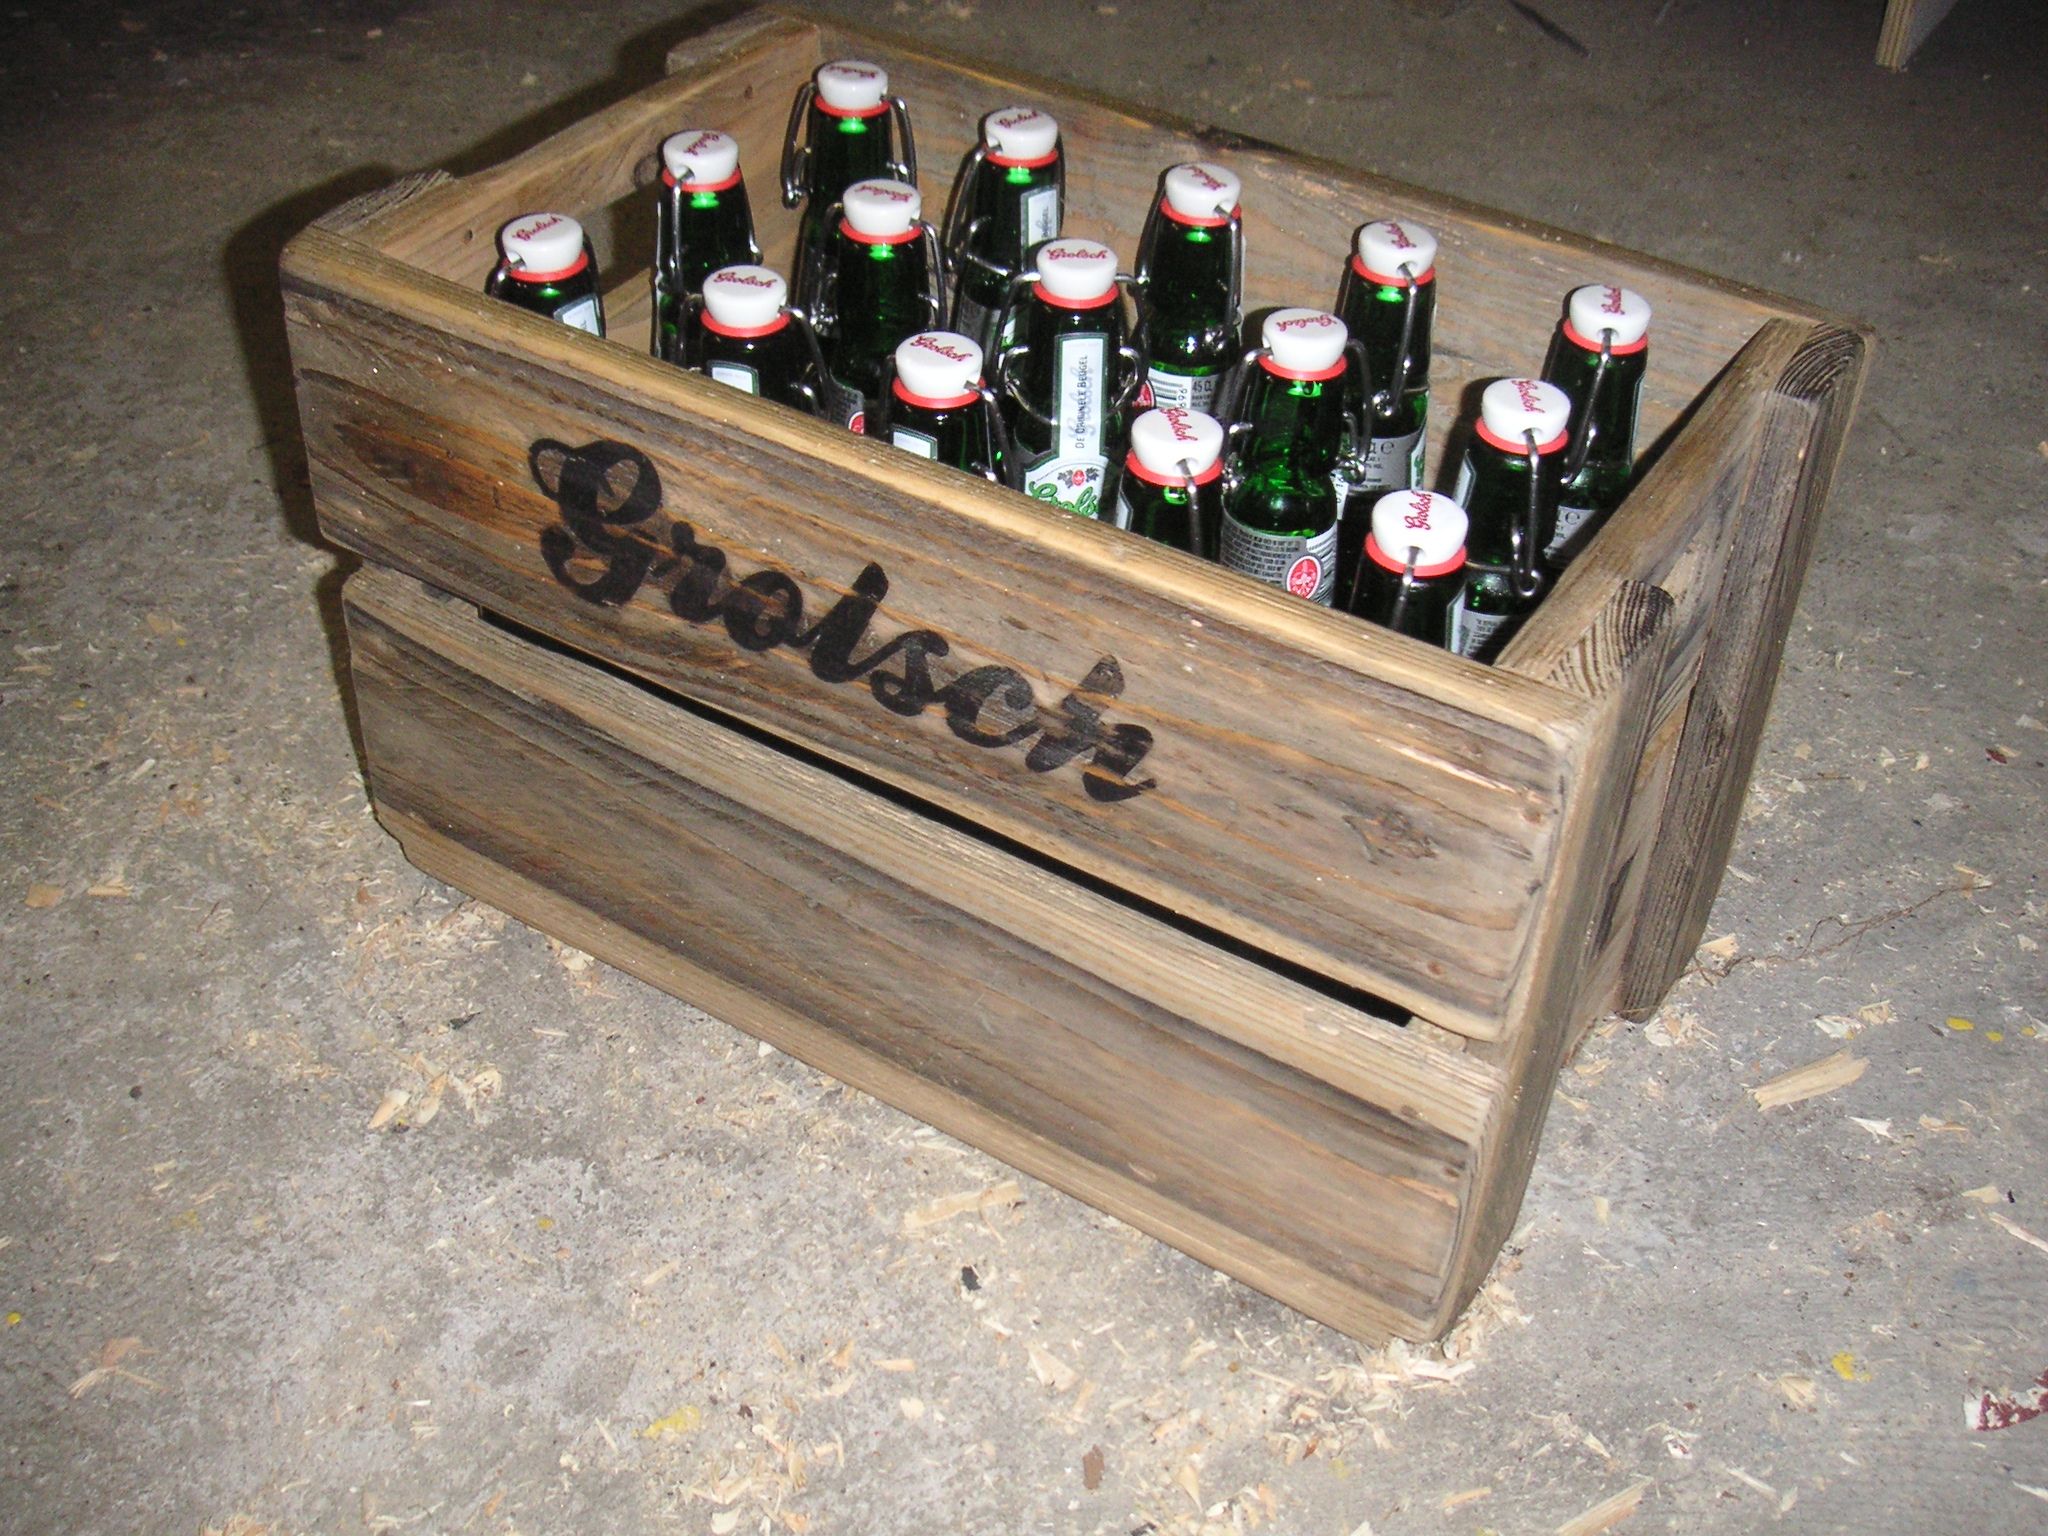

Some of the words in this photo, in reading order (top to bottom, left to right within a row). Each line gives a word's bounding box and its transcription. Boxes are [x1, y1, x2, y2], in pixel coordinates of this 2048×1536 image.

[1046, 248, 1108, 261] Grolsch
[713, 271, 778, 289] Grolsch
[1276, 313, 1339, 332] Grolsch
[909, 335, 974, 363] Grolsch
[1403, 490, 1433, 532] Grolsch
[528, 437, 1157, 802] Grolsch
